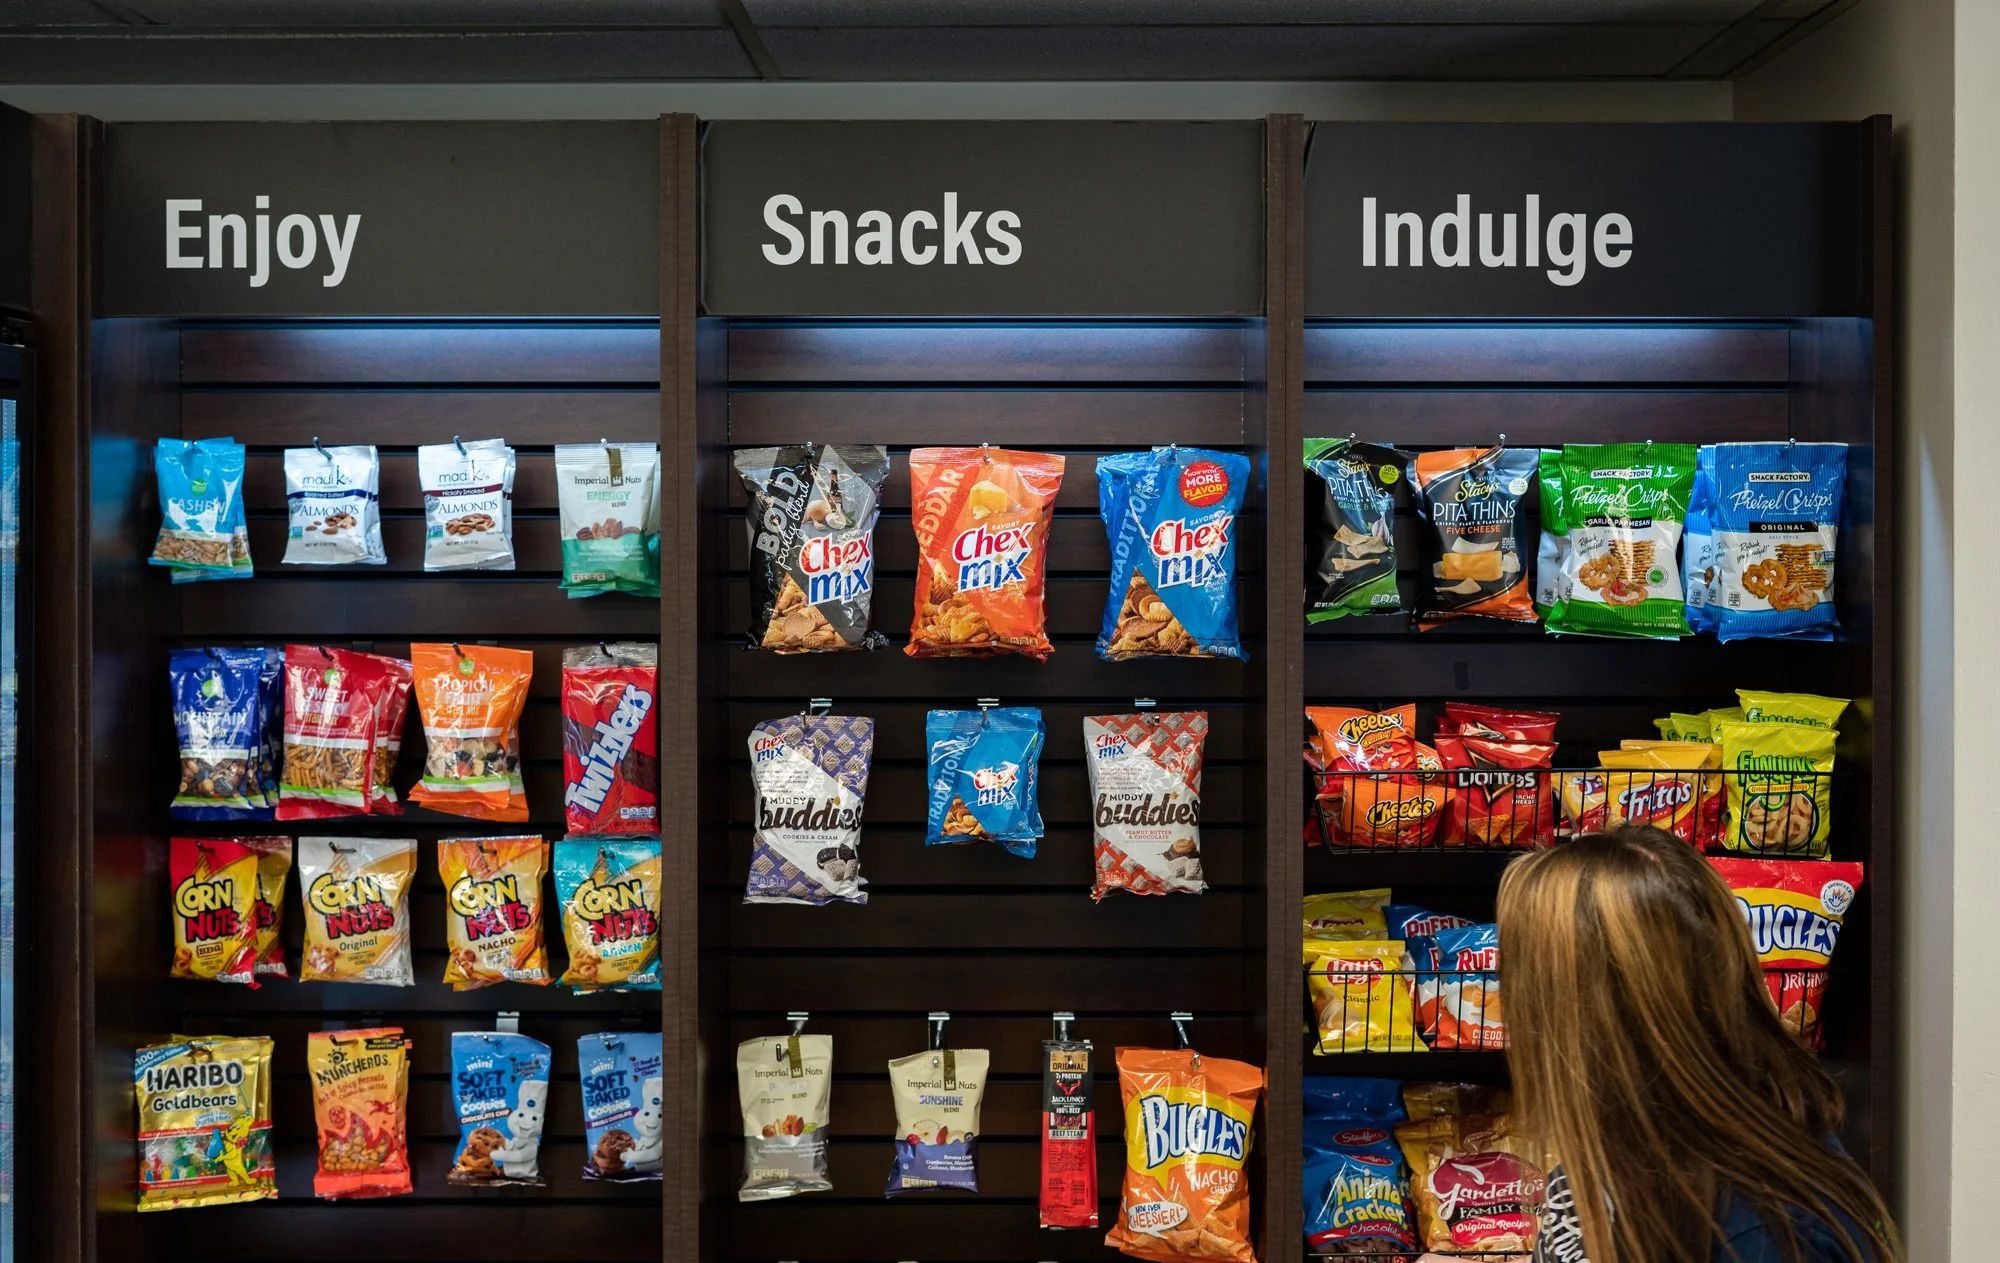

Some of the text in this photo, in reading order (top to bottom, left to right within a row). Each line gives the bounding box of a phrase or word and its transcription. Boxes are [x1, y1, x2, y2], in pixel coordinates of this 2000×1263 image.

[762, 192, 1022, 265] Snacks
[1363, 194, 1633, 286] Indulge
[166, 195, 361, 287] Enjoy
[574, 476, 641, 485] Imperial Nuts
[1183, 484, 1223, 498] FLAVOR
[1186, 474, 1221, 488] MORE
[1328, 477, 1355, 498] PITA
[1454, 479, 1499, 502] Stacy's
[168, 498, 225, 513] ASHEW
[438, 500, 498, 513] ALMONDS
[586, 491, 631, 500] ENERGY
[786, 479, 810, 525] blend
[1570, 482, 1669, 512] Pretzel Crisps
[1730, 487, 1833, 519] Pretzel Crisps
[300, 504, 359, 517] ALMONDS
[757, 471, 800, 556] BOLD
[1433, 500, 1516, 521] PITA THINS
[992, 520, 1020, 530] SAVORY
[1446, 525, 1501, 535] FIVE CHEESE
[1587, 518, 1651, 527] GARLIC PARMESAN
[775, 520, 807, 571] party
[953, 521, 1036, 563] Chex
[1151, 515, 1234, 557] Chex
[800, 531, 871, 575] Chex
[959, 551, 1031, 592] mix
[1158, 547, 1227, 588] mix
[808, 560, 871, 606] mix
[307, 687, 348, 703] SWEET
[1338, 713, 1403, 745] Cheetos
[754, 733, 785, 753] Chex
[1096, 733, 1128, 749] Chex
[1098, 742, 1127, 759] mix
[756, 744, 785, 763] mix
[769, 797, 806, 805] MUDDY
[977, 780, 1018, 806] mix
[1109, 793, 1144, 801] MUDDY
[1618, 780, 1692, 821] Fritos
[759, 797, 862, 831] buddies
[1095, 793, 1199, 828] buddies
[1366, 797, 1436, 828] Cheetos
[175, 876, 233, 918] CORN
[309, 872, 383, 915] CORN
[450, 874, 518, 918] CORN
[572, 879, 644, 921] CORN
[185, 905, 240, 943] NUTS
[326, 902, 394, 939] NUTS
[465, 901, 531, 942] NUTS
[589, 908, 657, 946] NUTS
[339, 936, 378, 951] Original
[478, 937, 516, 952] NACHO
[1330, 958, 1384, 984] Lay's
[316, 1054, 388, 1086] MUNCHEROS
[466, 1059, 493, 1071] mini
[591, 1061, 614, 1075] mini
[755, 1069, 788, 1078] Imperial
[1052, 1062, 1085, 1071] ORIGINAL
[147, 1062, 243, 1092] HARIBO
[457, 1070, 505, 1090] SOFT
[582, 1070, 627, 1095] SOFT
[907, 1080, 977, 1089] Imperial Nuts
[153, 1094, 237, 1112] Goldbears
[458, 1085, 507, 1103] BAKED
[585, 1086, 631, 1107] BAKED
[920, 1095, 963, 1106] SUNSHINE
[460, 1099, 507, 1115] Cookies
[461, 1109, 510, 1123] CHOCOLATE CHIP
[587, 1100, 631, 1119] Cookies
[608, 1111, 632, 1123] CHOCOLATE
[1140, 1095, 1247, 1169] BUGLES
[1190, 1169, 1239, 1192] NACHO
[1335, 1168, 1403, 1207] Anima
[1428, 1156, 1544, 1220] Gardetto's
[1129, 1206, 1180, 1229] CHEESIER!
[1135, 1203, 1161, 1213] NOW EVEN
[1333, 1200, 1408, 1231] Cracker
[1460, 1204, 1515, 1219] FAMILY
[1456, 1219, 1531, 1234] Original Recipe
